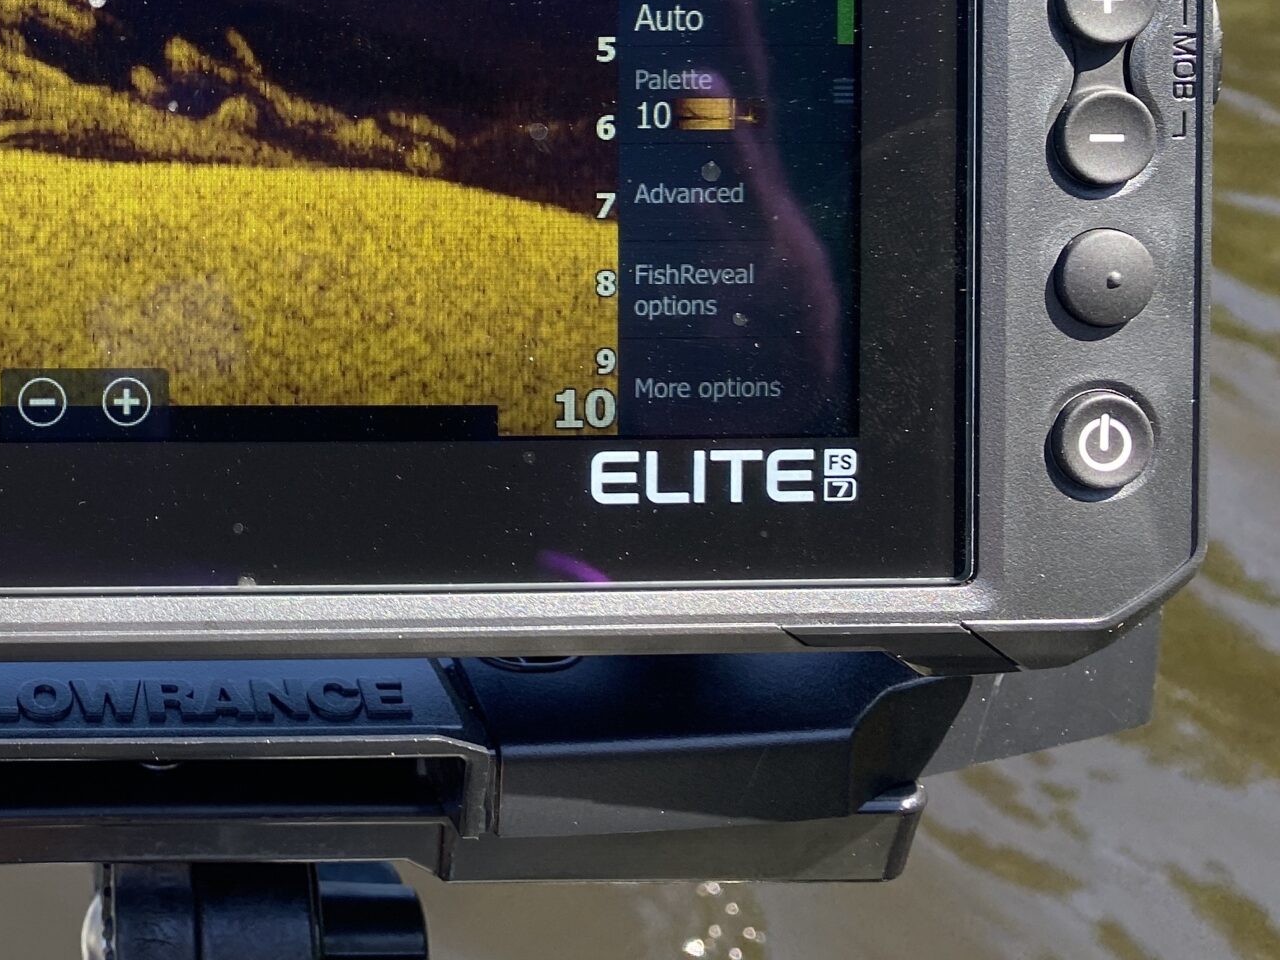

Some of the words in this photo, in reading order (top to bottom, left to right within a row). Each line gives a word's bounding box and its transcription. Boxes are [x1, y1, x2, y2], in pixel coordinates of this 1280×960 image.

[634, 4, 704, 31] Auto
[596, 36, 616, 63] 5
[635, 70, 712, 91] Palette
[1172, 32, 1196, 102] MOB
[596, 115, 616, 141] 6
[636, 102, 671, 130] 10
[596, 192, 616, 220] 7
[634, 183, 745, 204] Advanced
[595, 270, 617, 298] 8
[635, 264, 755, 286] FishReveal
[634, 296, 718, 321] options
[596, 347, 617, 376] 9
[635, 378, 691, 398] More
[697, 378, 781, 400] options
[553, 388, 617, 429] 10
[590, 449, 814, 505] ELITE
[829, 454, 852, 470] FS
[831, 481, 849, 498] 7
